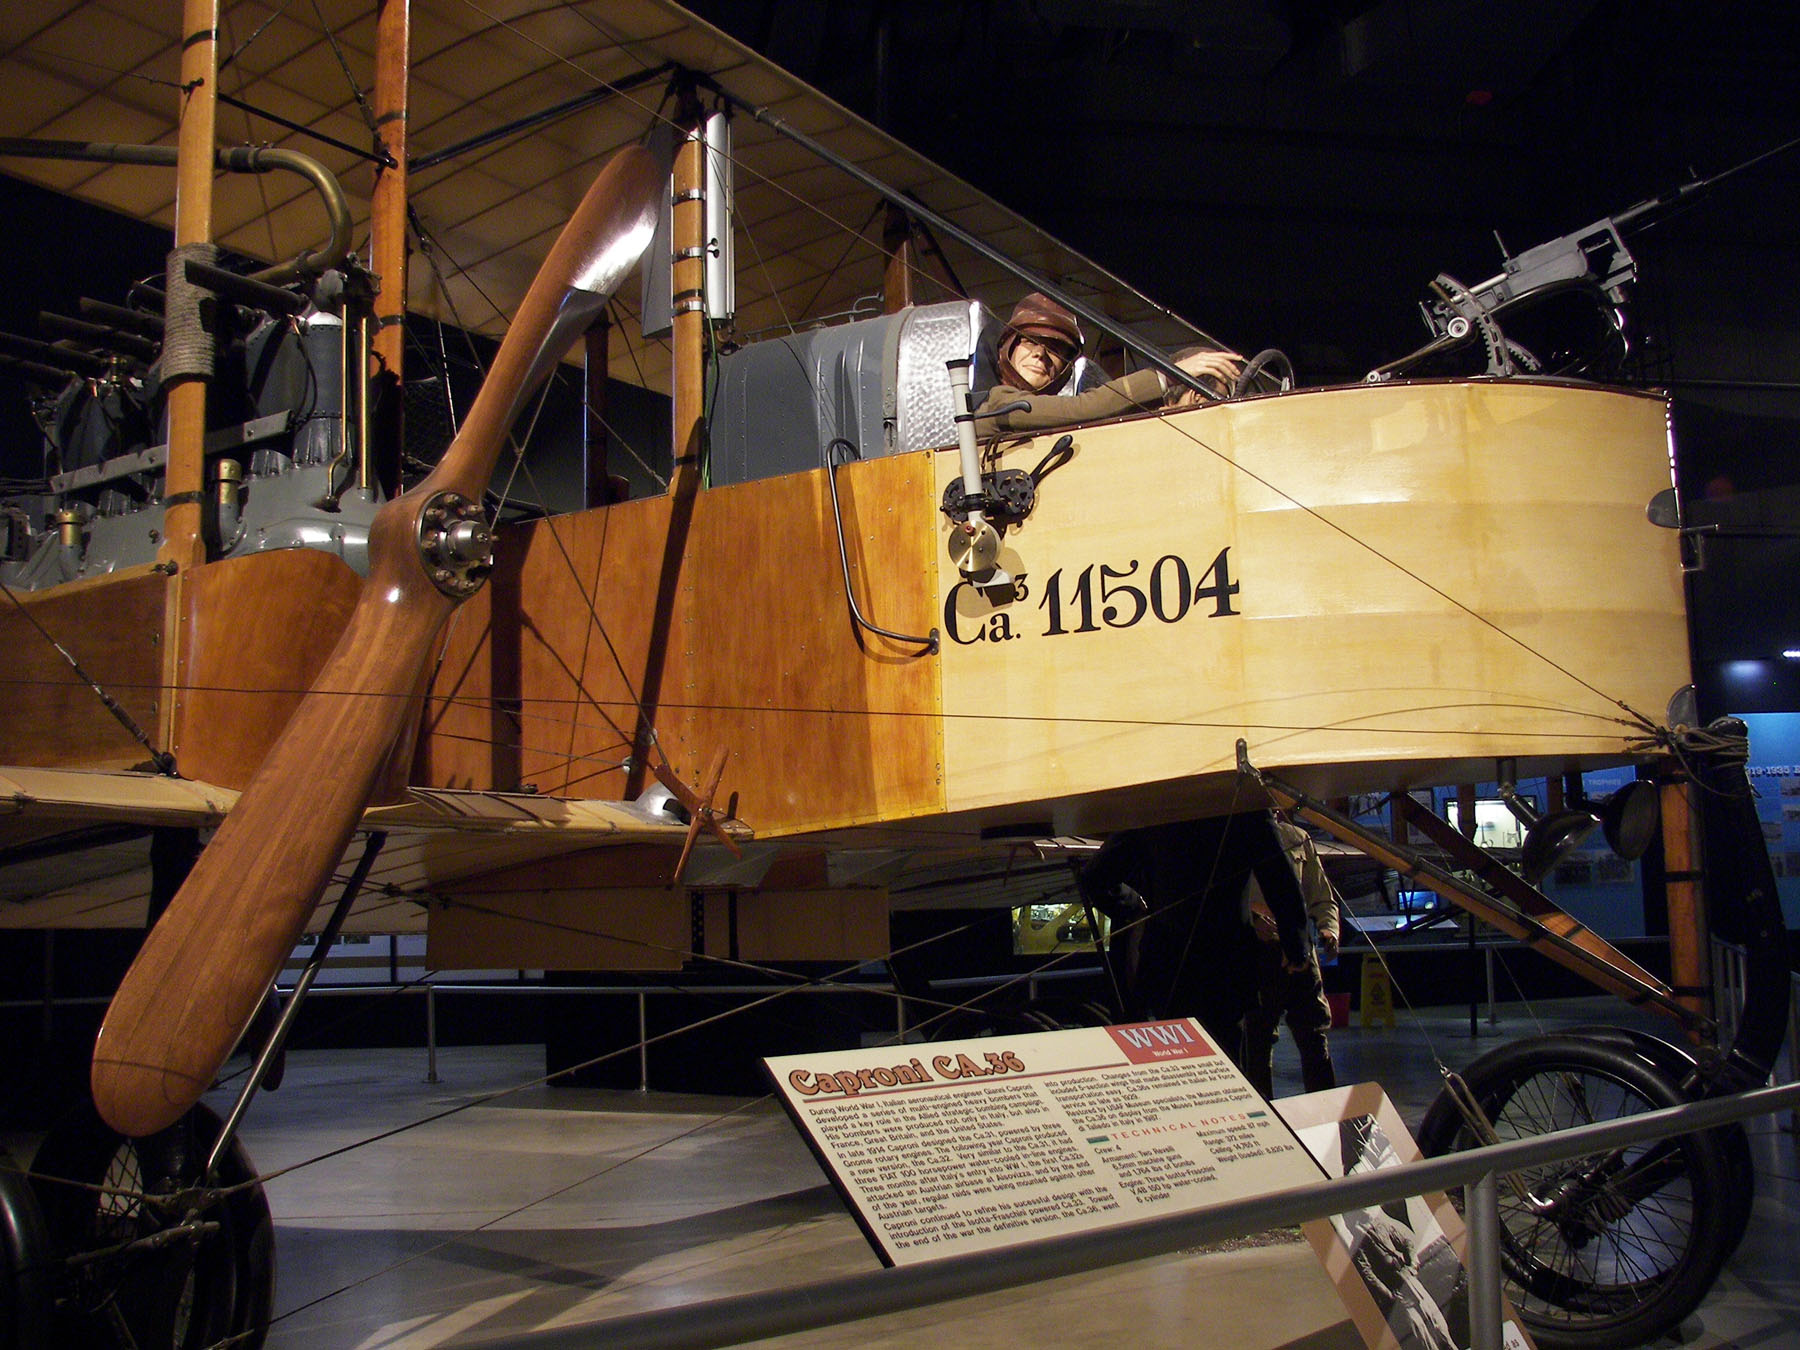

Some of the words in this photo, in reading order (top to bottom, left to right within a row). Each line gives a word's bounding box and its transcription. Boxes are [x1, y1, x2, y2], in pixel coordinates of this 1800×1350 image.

[1039, 546, 1241, 636] 11504
[1117, 1023, 1195, 1049] WWI
[788, 1057, 934, 1096] Caproni
[932, 1050, 1026, 1080] CA.36
[815, 1112, 860, 1124] developed
[870, 1109, 896, 1117] series
[898, 1106, 907, 1114] of
[909, 1100, 963, 1112] multi-engined
[963, 1098, 987, 1106] heavy
[987, 1094, 1022, 1103] bombers
[820, 1122, 849, 1134] played
[875, 1117, 892, 1126] role
[918, 1111, 940, 1120] Allied
[941, 1107, 975, 1117] strategic
[974, 1103, 1008, 1113] bombing
[825, 1133, 841, 1141] His
[841, 1129, 881, 1139] bombers
[905, 1119, 944, 1132] produced
[945, 1117, 960, 1125] not
[961, 1115, 978, 1123] only
[847, 1150, 865, 1158] late
[866, 1146, 886, 1155] 1914
[887, 1141, 920, 1152] Caproni
[921, 1136, 957, 1148] designed
[998, 1126, 1030, 1138] powered
[863, 1135, 888, 1145] Great
[919, 1129, 935, 1137] and
[950, 1123, 977, 1133] United
[1111, 1121, 1197, 1141] TECHNICAL
[1201, 1113, 1247, 1127] NOTES
[857, 1167, 875, 1175] new
[911, 1159, 926, 1167] the
[977, 1147, 1002, 1157] similar
[874, 1154, 899, 1163] rotary
[951, 1142, 987, 1152] following
[987, 1139, 1004, 1148] year
[1004, 1134, 1033, 1144] Caproni
[1034, 1129, 1068, 1141] produced
[854, 1176, 878, 1185] three
[879, 1171, 898, 1181] FIAT
[900, 1169, 917, 1178] 100
[917, 1163, 966, 1175] horsepower
[968, 1153, 1021, 1167] water-cooled
[859, 1185, 885, 1194] Three
[886, 1179, 918, 1190] months
[919, 1176, 939, 1184] after
[966, 1169, 987, 1177] entry
[1003, 1162, 1020, 1170] WW
[1042, 1156, 1059, 1164] first
[872, 1203, 881, 1212] of
[883, 1202, 898, 1210] the
[922, 1193, 950, 1203] regular
[951, 1189, 971, 1198] raids
[972, 1187, 992, 1195] were
[992, 1182, 1016, 1191] being
[1016, 1175, 1048, 1187] mounted
[1049, 1171, 1076, 1182] against
[1076, 1169, 1095, 1177] other
[878, 1209, 913, 1221] Austrian
[883, 1218, 918, 1231] Caproni
[920, 1211, 961, 1225] continued
[974, 1206, 998, 1215] refine
[998, 1203, 1012, 1211] his
[1052, 1192, 1077, 1202] design
[1078, 1188, 1095, 1196] with
[888, 1226, 940, 1240] introduction
[941, 1222, 950, 1231] of
[951, 1221, 966, 1229] the
[1028, 1203, 1061, 1216] powered
[1088, 1193, 1115, 1203] Toward
[895, 1241, 910, 1249] the
[913, 1236, 930, 1246] end
[931, 1234, 941, 1243] of
[943, 1232, 958, 1240] the
[959, 1229, 975, 1237] war
[976, 1226, 991, 1234] the
[993, 1219, 1029, 1231] definitive
[1061, 1210, 1075, 1218] the
[1101, 1201, 1120, 1210] went
